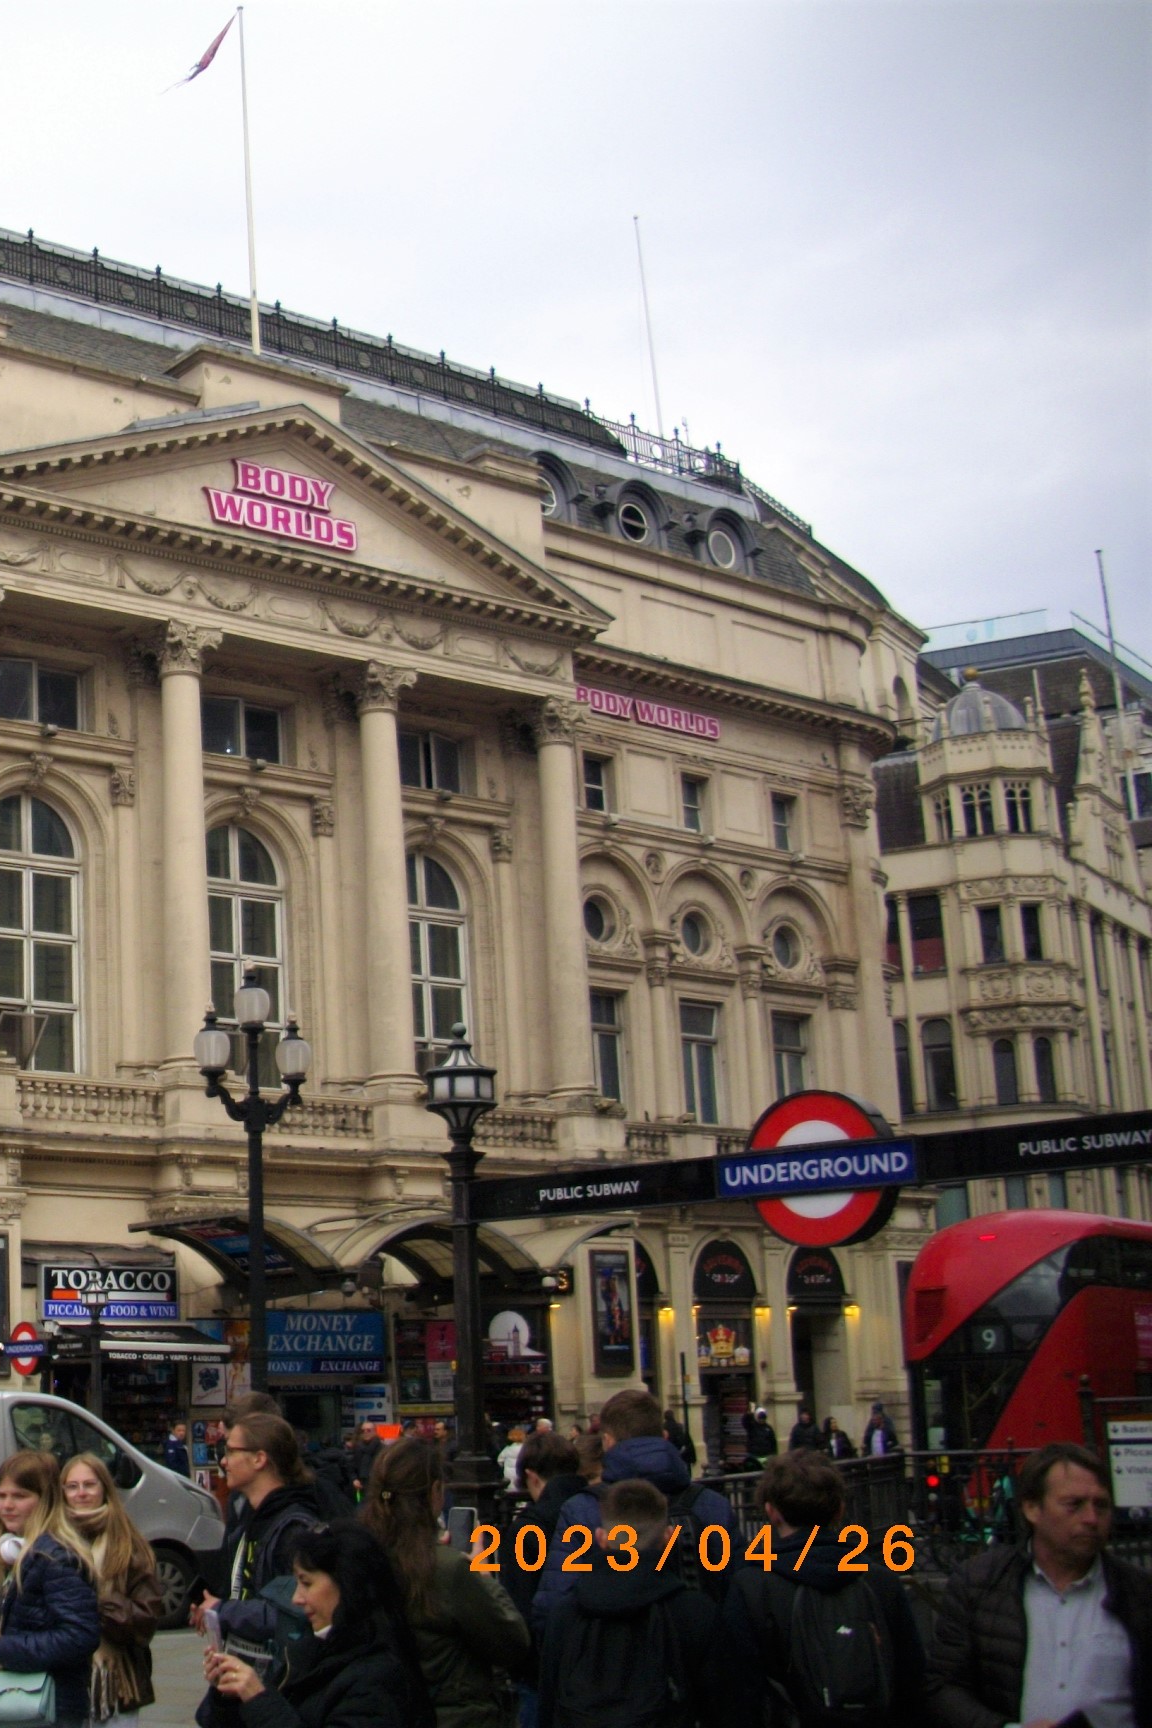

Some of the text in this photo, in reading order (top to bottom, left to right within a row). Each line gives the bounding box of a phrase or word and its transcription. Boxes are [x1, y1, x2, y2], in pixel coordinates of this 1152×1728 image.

[238, 461, 335, 510] BODY
[210, 489, 357, 550] WORLDS
[576, 686, 721, 739] BODY WORLDS
[1018, 1129, 1152, 1156] PUBLIC SUBWAY
[724, 1152, 908, 1187] UNDERGROUND
[539, 1180, 640, 1201] PUBLIC SUBWAY
[51, 1269, 171, 1291] TOBACCO
[110, 1305, 138, 1316] FOOD
[139, 1306, 147, 1316] &
[149, 1306, 176, 1317] WINE
[285, 1314, 357, 1331] MONEY
[5, 1344, 44, 1354] UNDERGROUND
[267, 1334, 375, 1352] EXCHANGE
[981, 1328, 997, 1350] 9
[108, 1352, 137, 1360] TOBACCO
[319, 1361, 380, 1372] EXCHANGE
